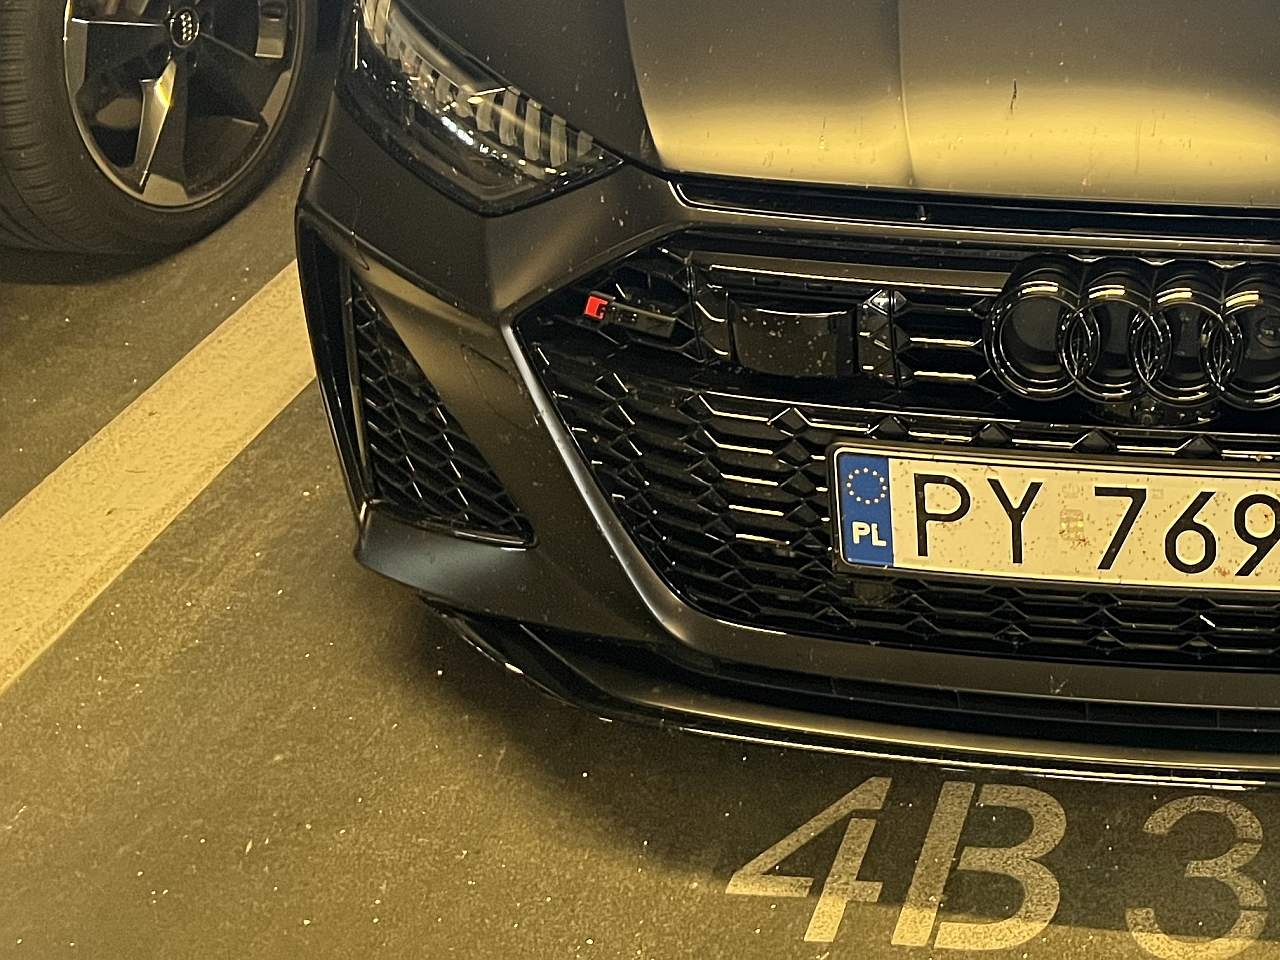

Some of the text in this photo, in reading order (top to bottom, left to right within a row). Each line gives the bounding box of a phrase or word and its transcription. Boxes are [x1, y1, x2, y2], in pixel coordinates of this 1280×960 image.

[851, 521, 888, 547] PL
[913, 472, 1044, 565] PY
[724, 775, 1067, 951] 4B
